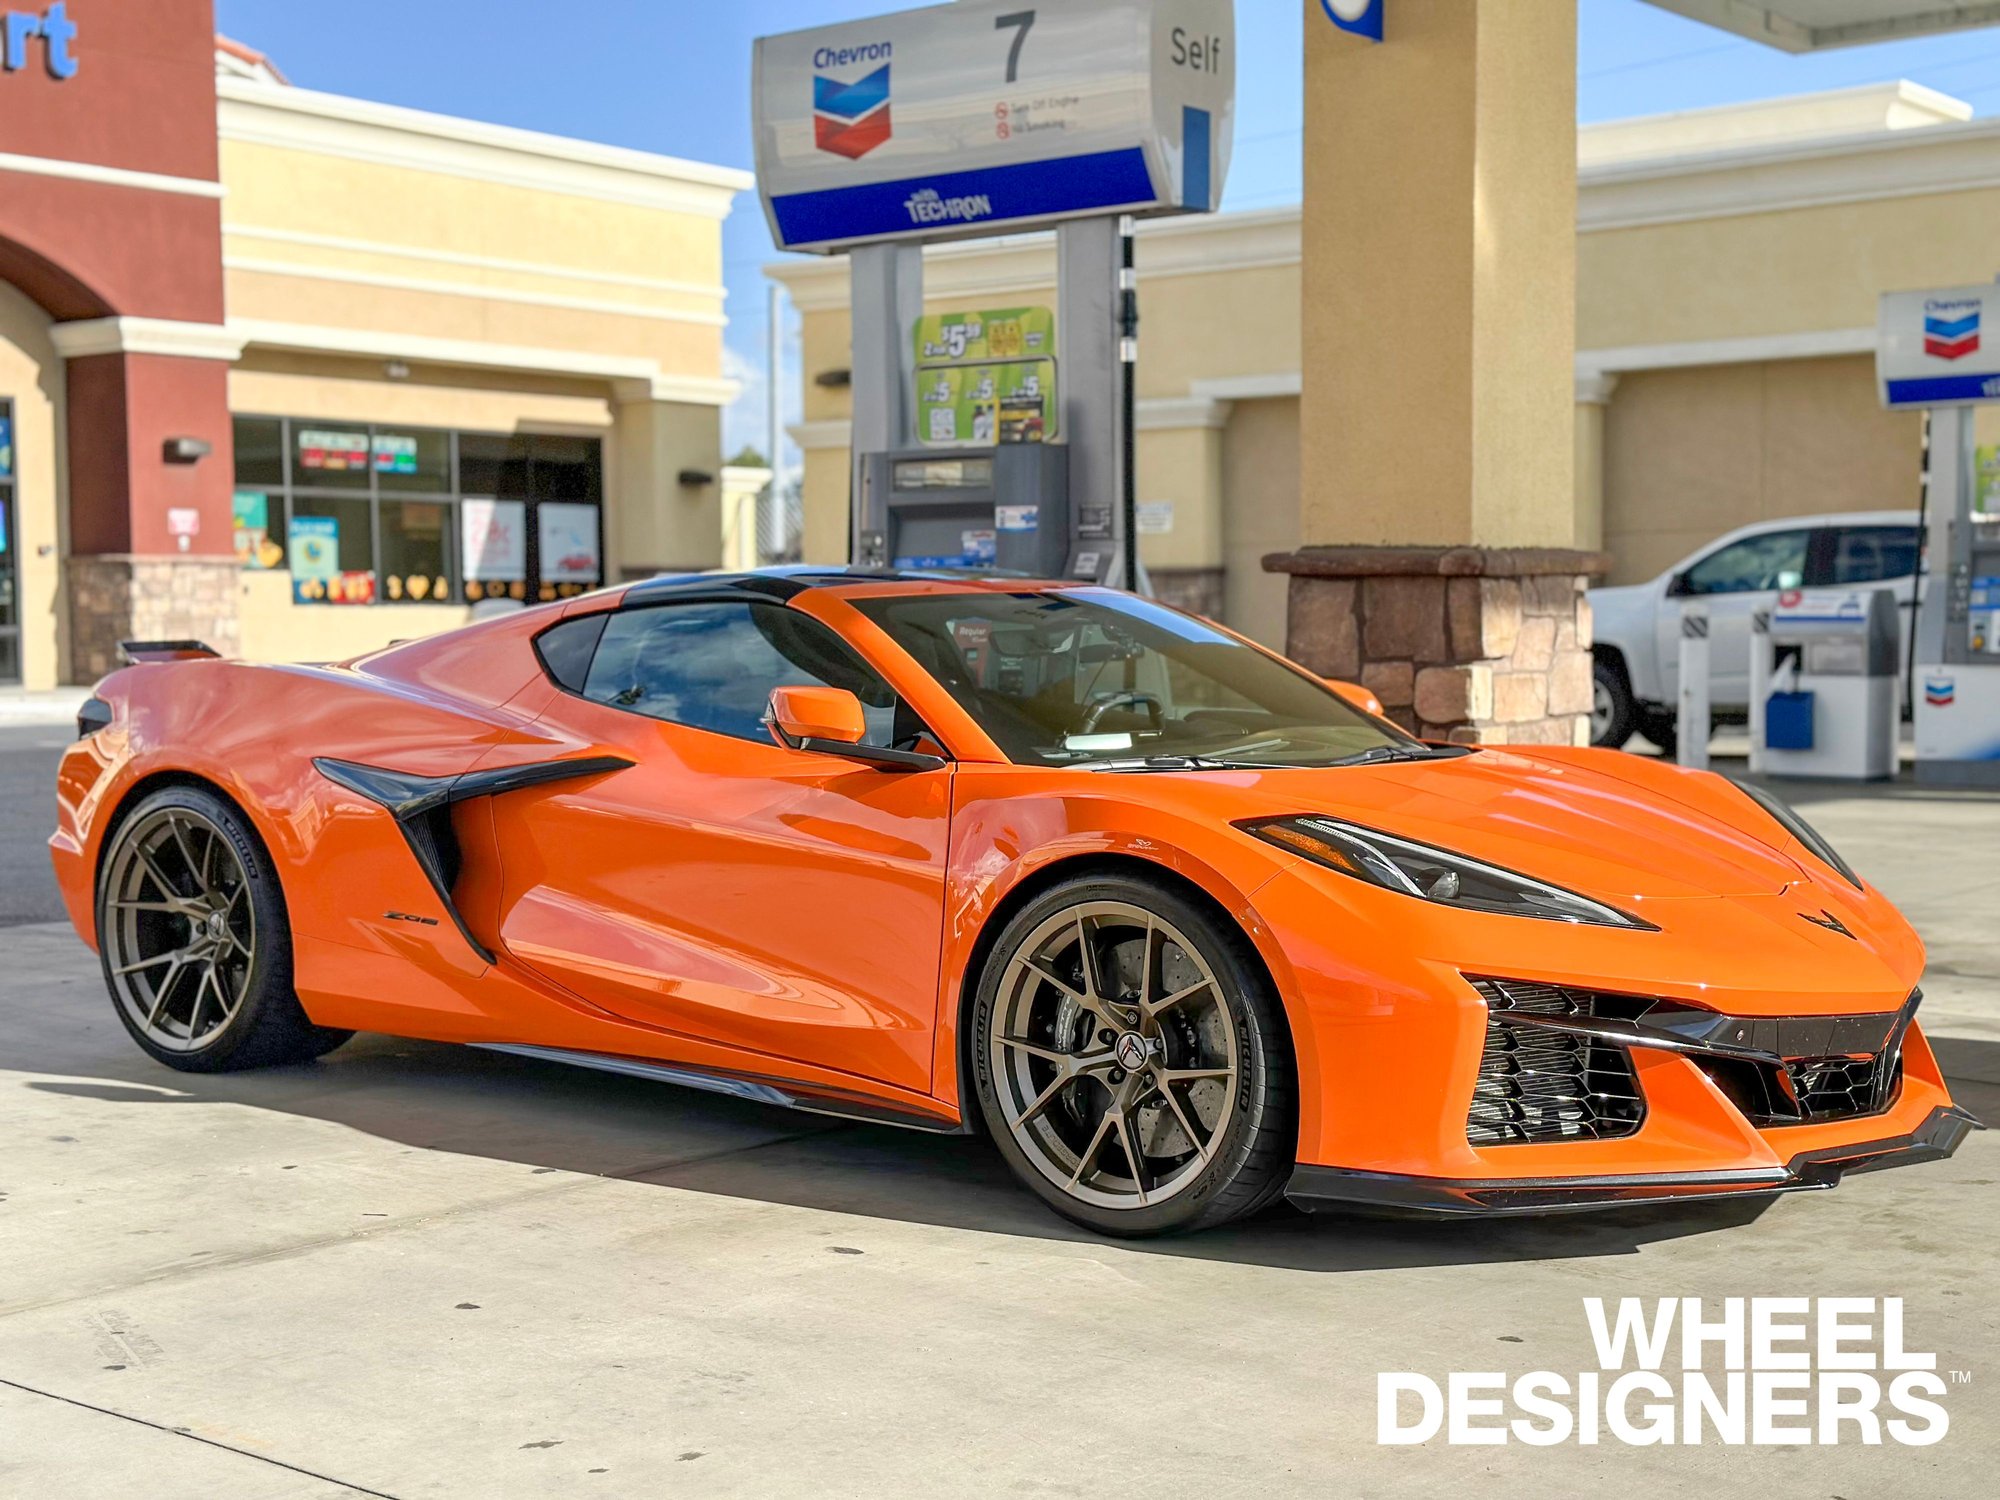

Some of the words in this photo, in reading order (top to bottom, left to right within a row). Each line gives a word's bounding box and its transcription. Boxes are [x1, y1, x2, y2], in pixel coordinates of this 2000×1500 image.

[814, 41, 892, 69] Chevron
[995, 9, 1036, 83] 7
[1171, 27, 1220, 74] Self
[904, 194, 992, 224] TECHRON
[1239, 1026, 1252, 1111] MICHELIN
